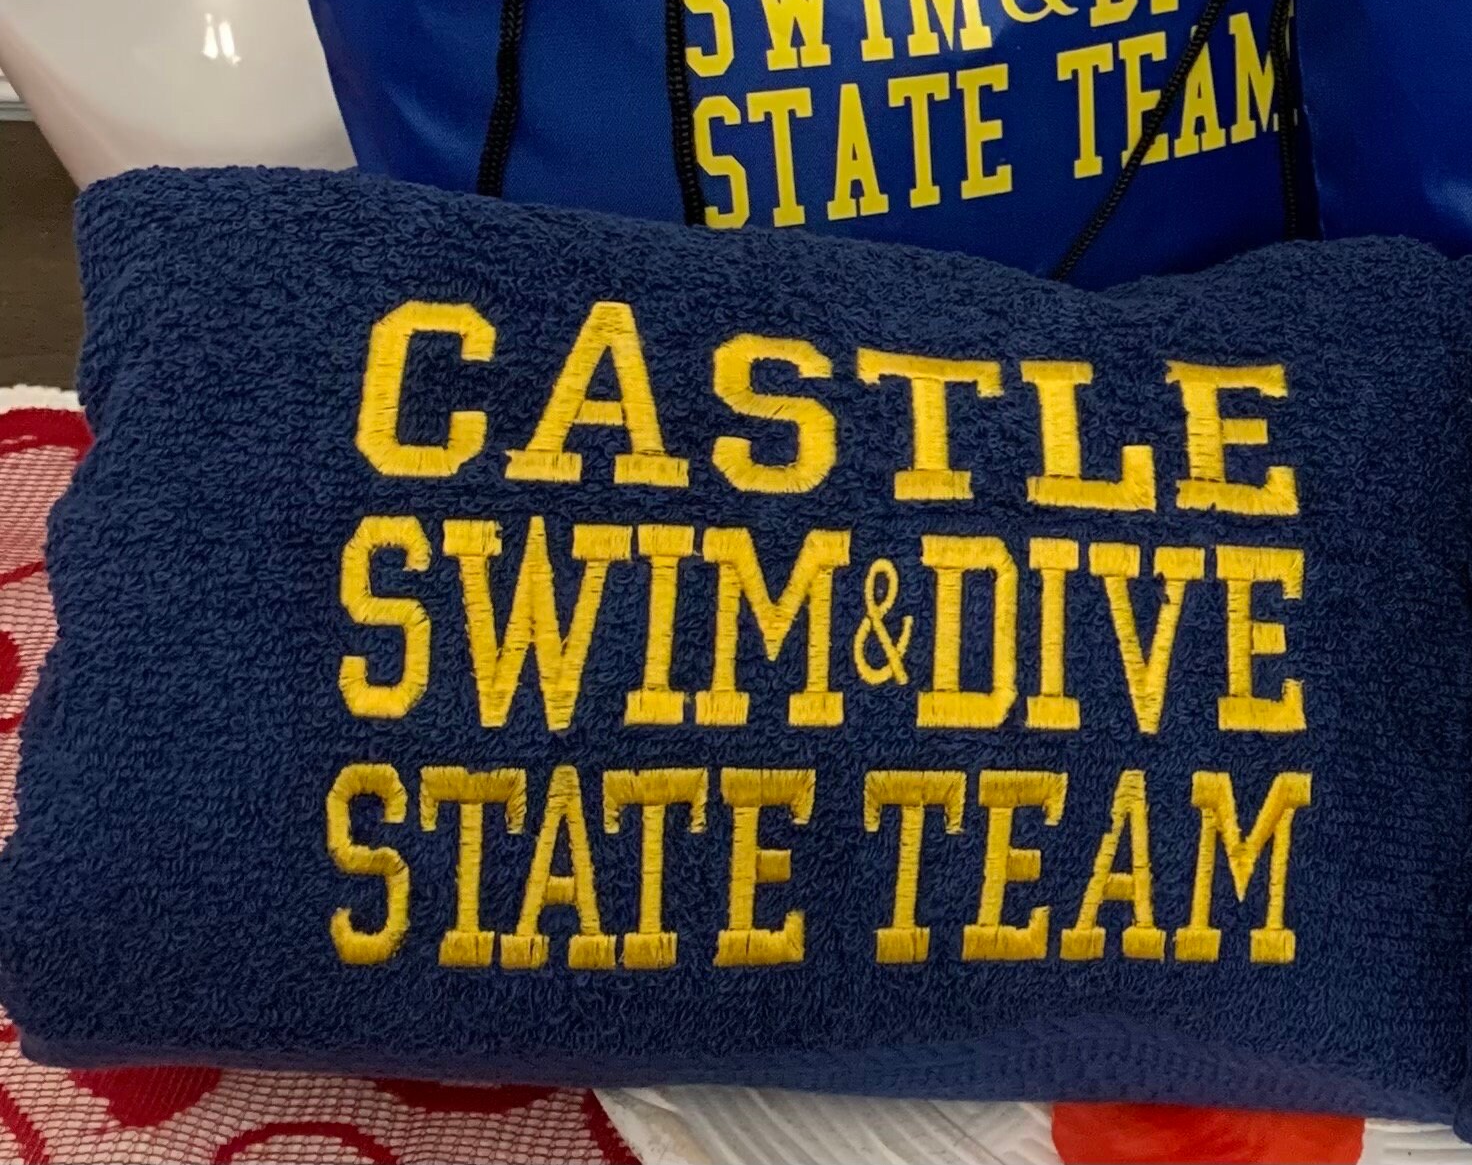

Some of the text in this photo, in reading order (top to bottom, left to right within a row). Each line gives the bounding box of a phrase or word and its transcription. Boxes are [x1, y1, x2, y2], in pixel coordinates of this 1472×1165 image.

[693, 0, 1297, 230] STATE TEAM
[354, 300, 1300, 516] CASTLE
[338, 516, 1306, 734] SWIM & DIVE
[326, 763, 1312, 969] STATE TEAM
